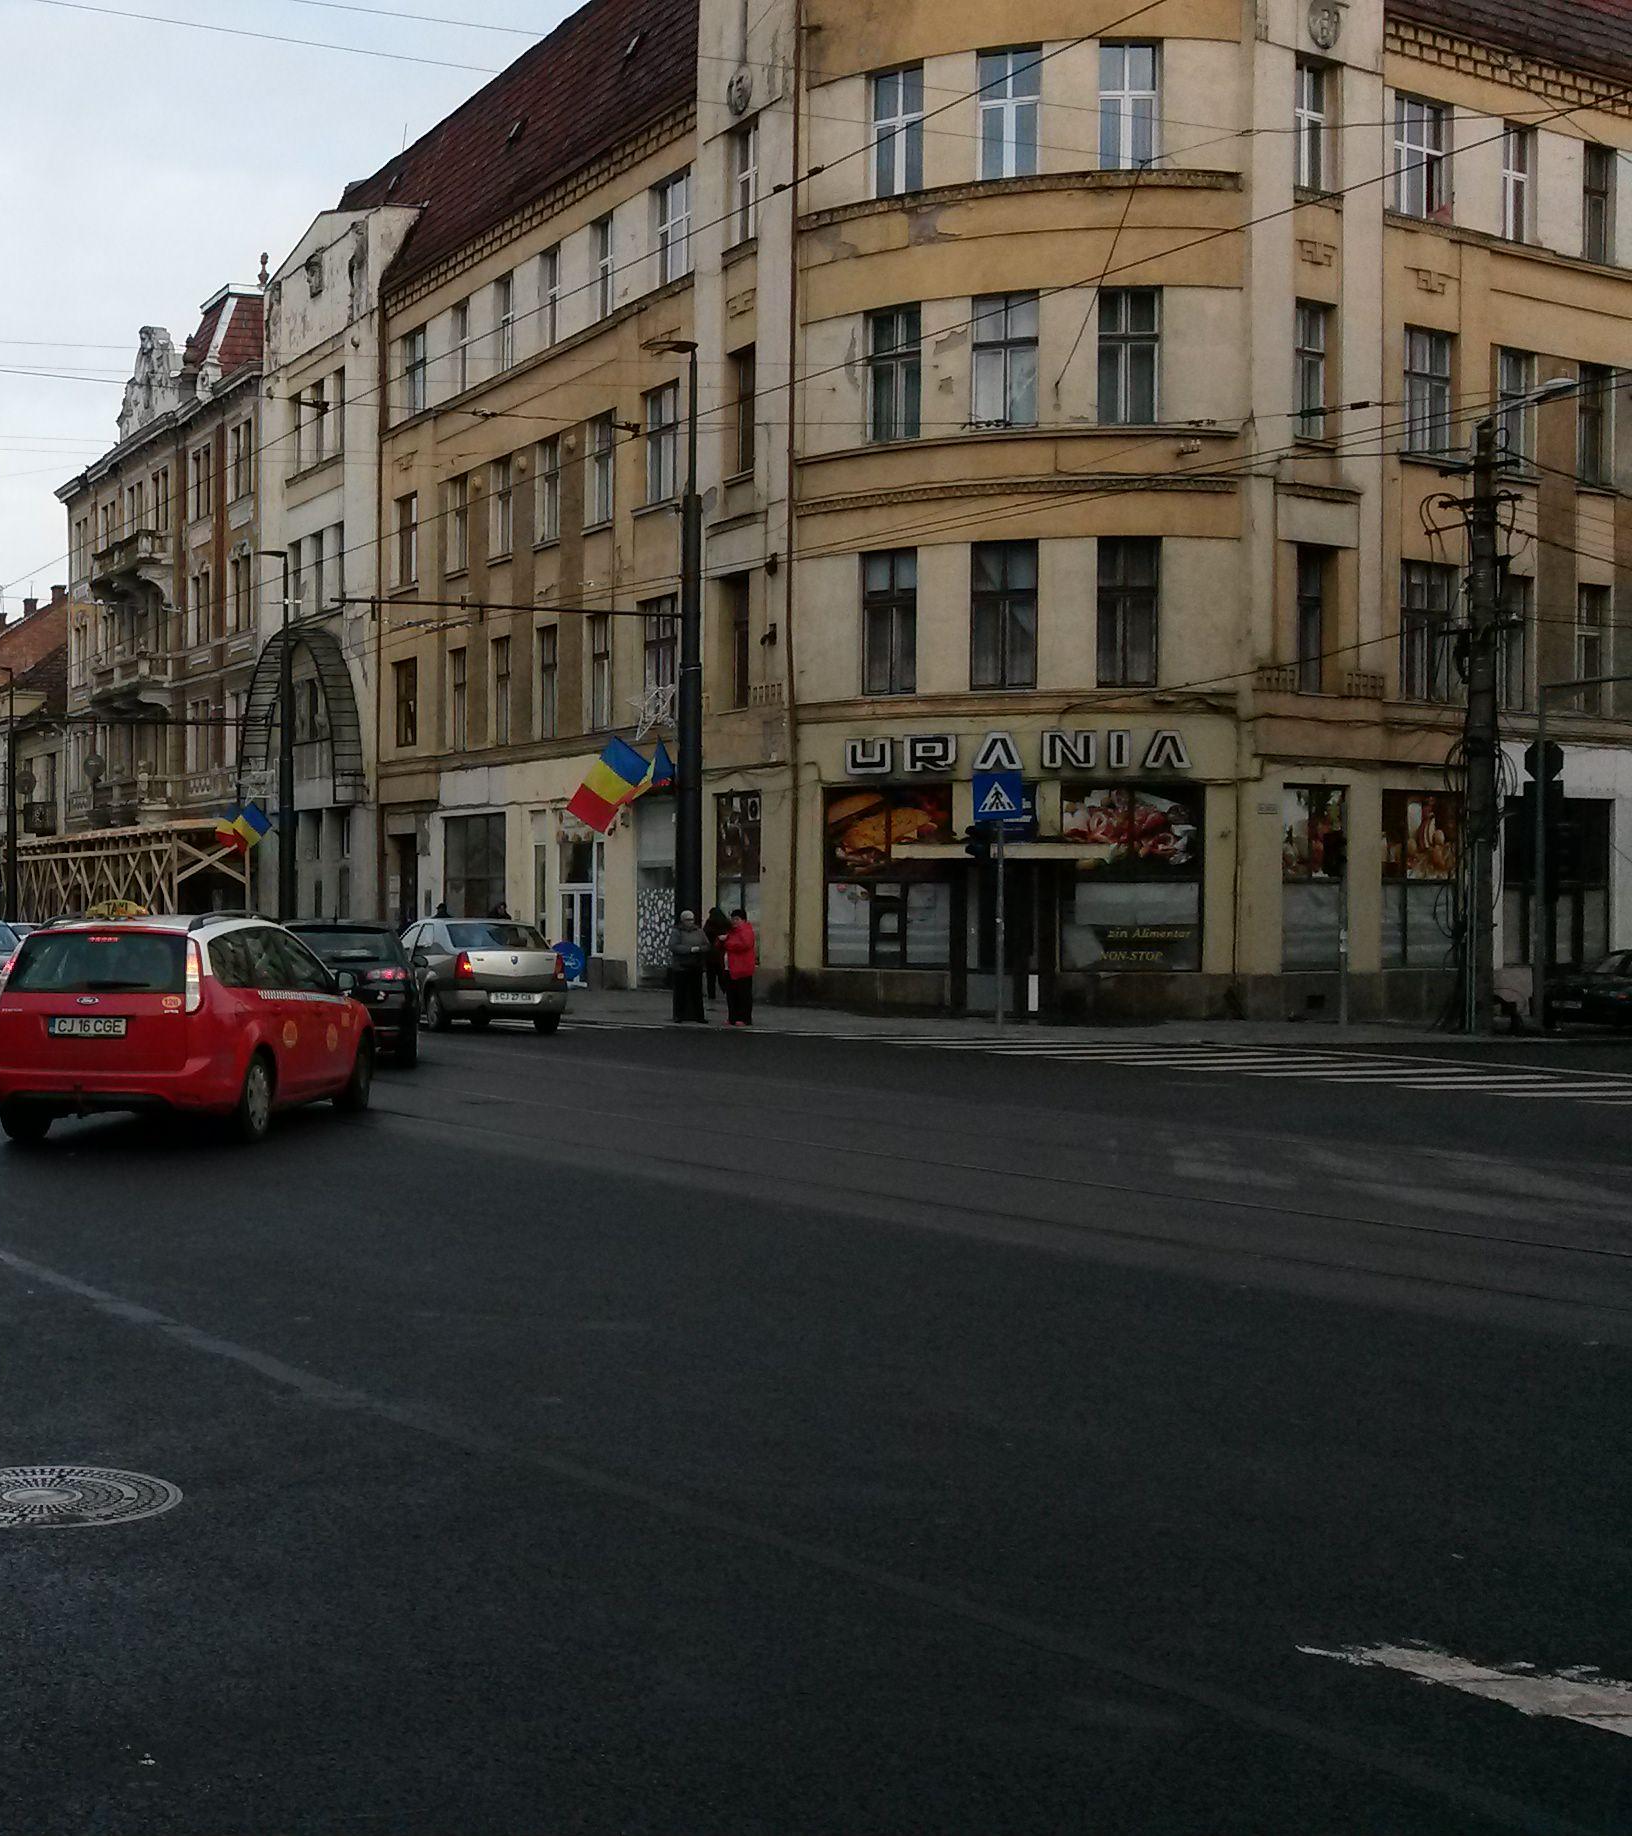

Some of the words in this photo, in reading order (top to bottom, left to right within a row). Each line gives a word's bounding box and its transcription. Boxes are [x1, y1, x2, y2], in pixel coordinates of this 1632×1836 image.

[845, 730, 1192, 775] URANIA
[1099, 951, 1164, 961] NON-STOP
[58, 1019, 74, 1033] CJ
[79, 1019, 90, 1033] 16
[93, 1019, 122, 1033] CGE
